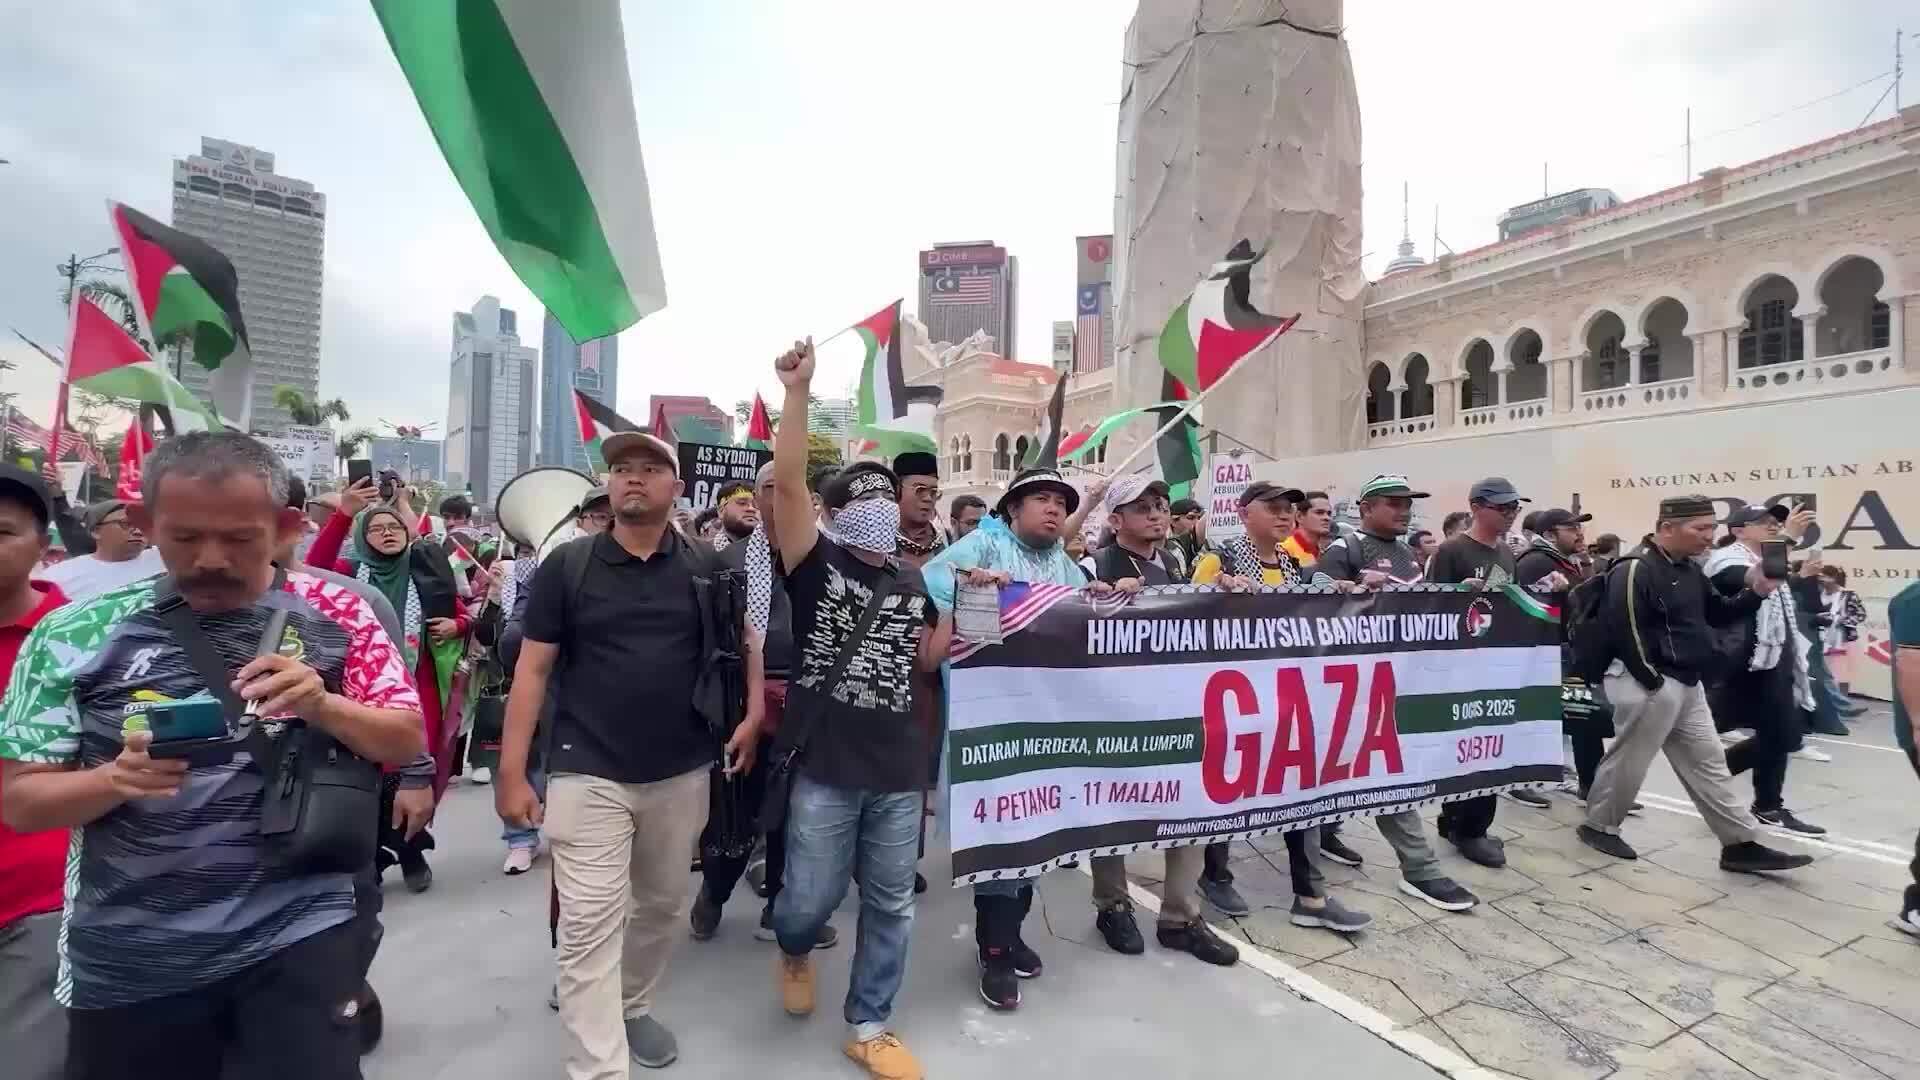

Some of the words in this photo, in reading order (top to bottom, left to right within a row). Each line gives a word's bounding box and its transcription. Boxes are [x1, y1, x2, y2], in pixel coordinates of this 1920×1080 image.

[697, 446, 713, 462] AS
[715, 449, 757, 467] SYDDIQ
[695, 463, 726, 478] STAND
[731, 466, 756, 480] WITH
[1216, 463, 1252, 483] GAZA
[1610, 471, 1737, 489] BANGUNAN
[1748, 463, 1858, 481] SULTAN
[694, 480, 722, 510] GA
[1088, 618, 1207, 655] HIMPUNAN
[1213, 616, 1314, 650] MALAYSIA
[1316, 613, 1398, 646] BANGKIT
[1401, 612, 1461, 642] UNTUK
[1452, 703, 1460, 721] 9
[1486, 699, 1516, 718] 2025
[1202, 661, 1405, 805] GAZA
[961, 738, 1020, 766] DATARAN
[1023, 737, 1092, 757] MERDEKA,
[1096, 735, 1140, 754] KUALA
[1142, 733, 1195, 753] LUMPUR
[1456, 733, 1505, 764] SABTU
[973, 797, 988, 824] 4
[996, 784, 1063, 823] PETANG
[1083, 780, 1102, 807] 11
[1108, 779, 1182, 804] MALAM
[1156, 815, 1246, 836] #HUMANITYFORGAZA
